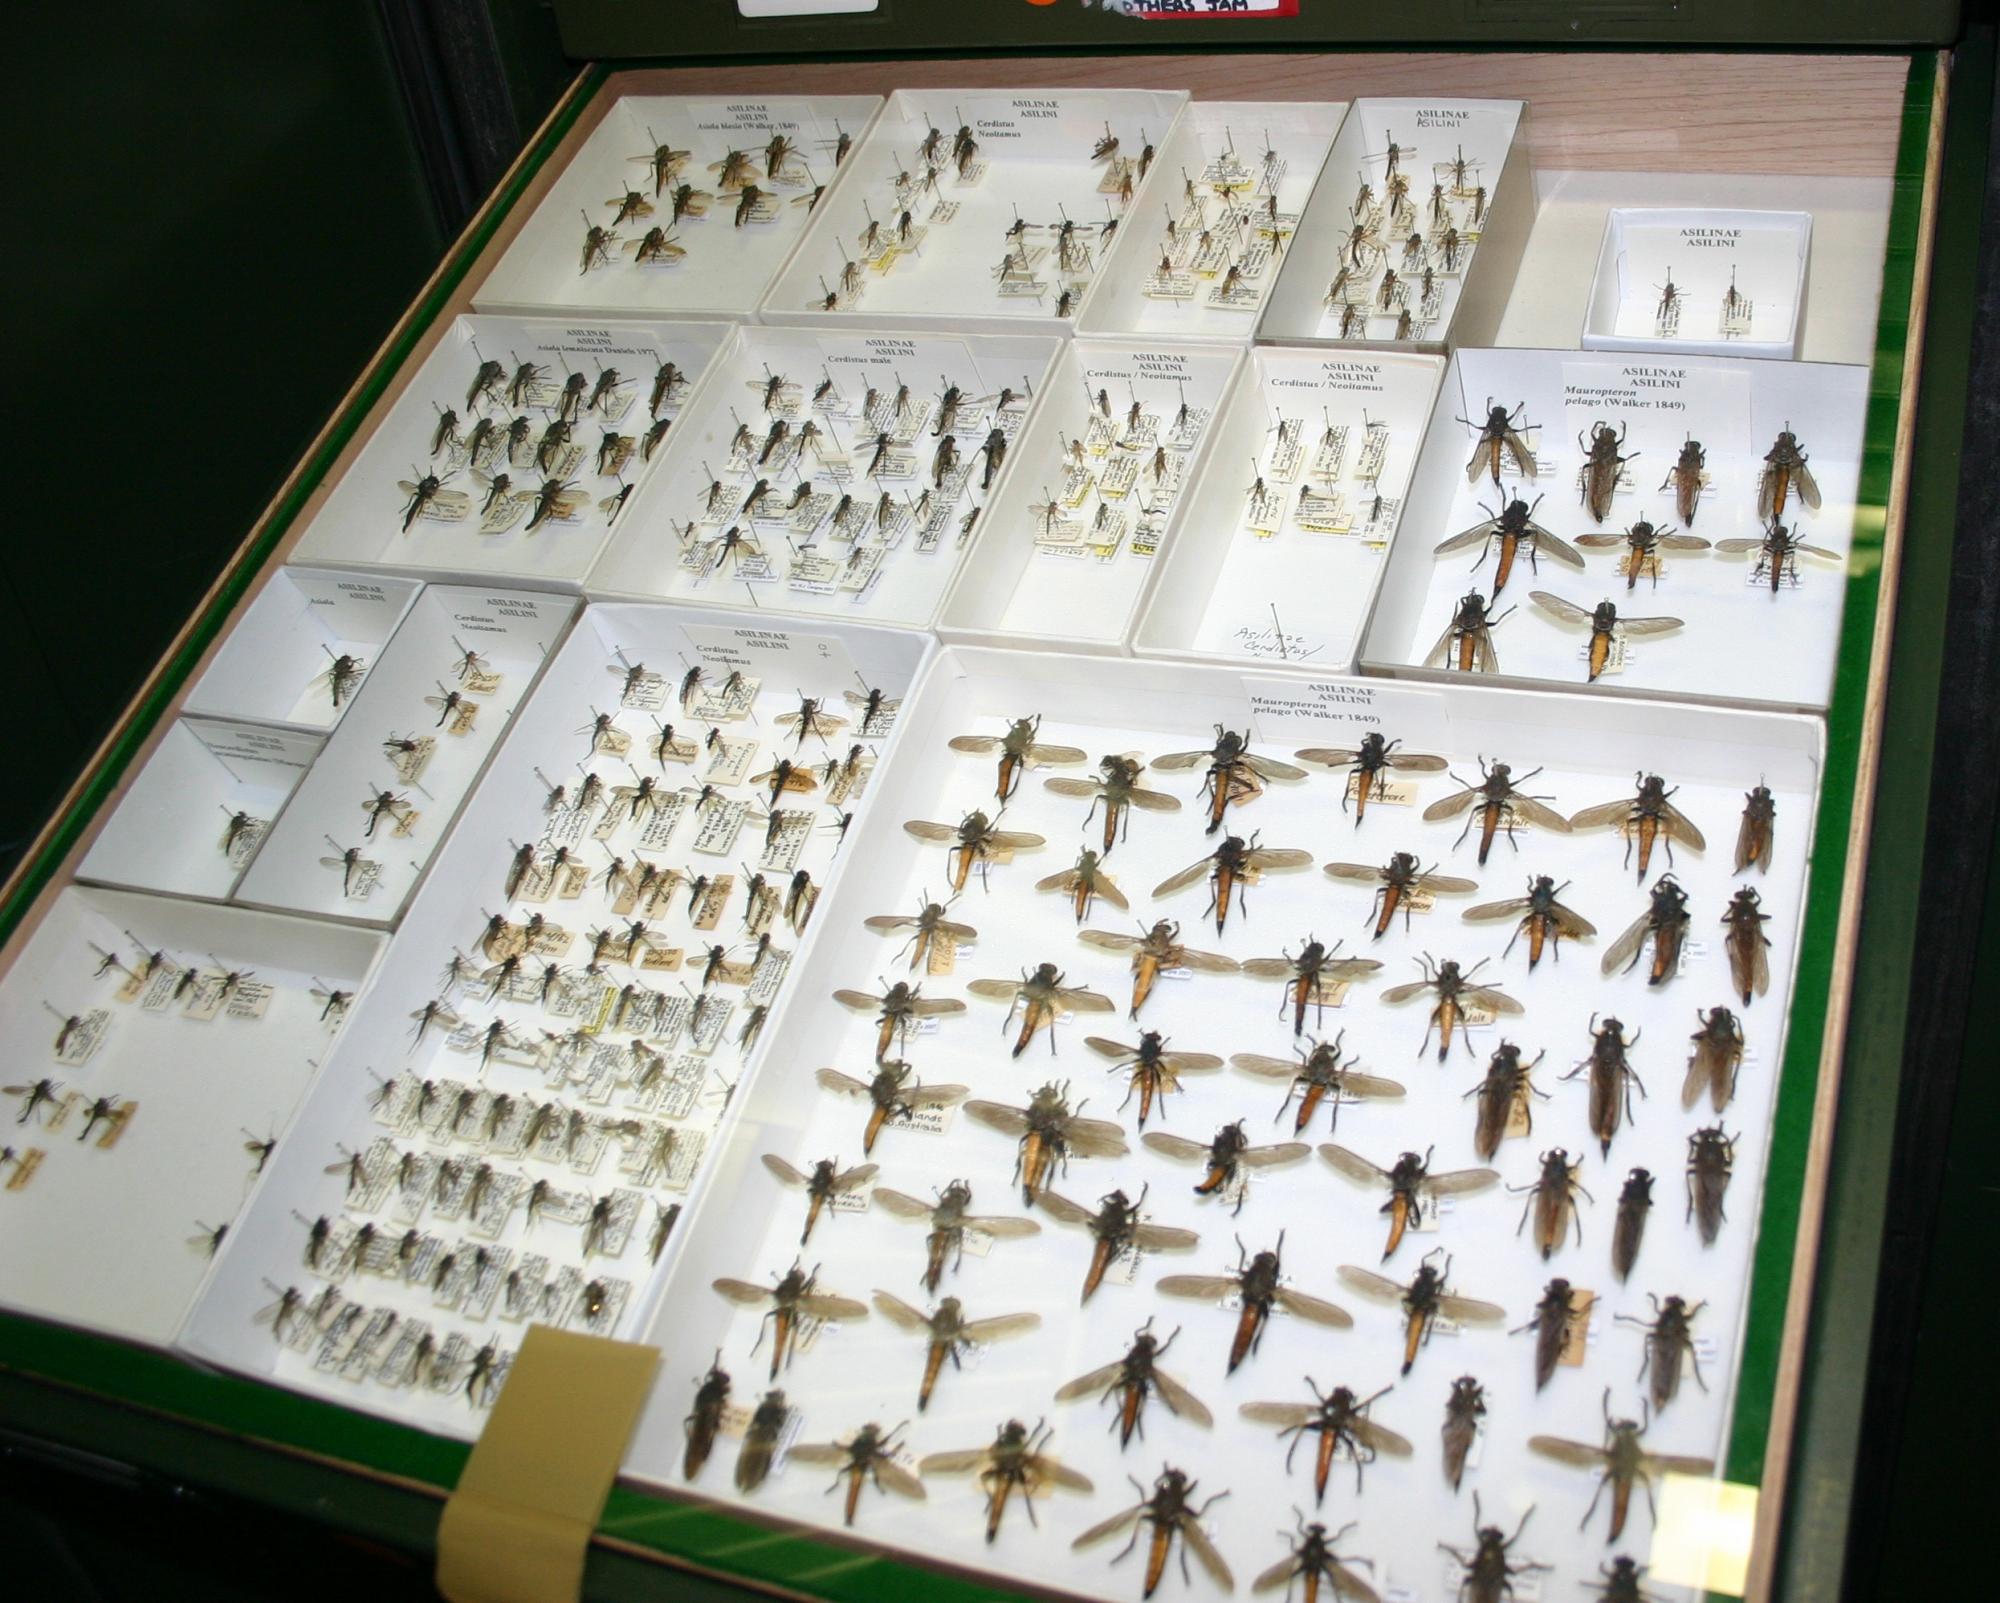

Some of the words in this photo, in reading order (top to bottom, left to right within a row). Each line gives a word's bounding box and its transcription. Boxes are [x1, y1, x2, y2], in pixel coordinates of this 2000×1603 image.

[1205, 0, 1248, 11] JAM
[726, 104, 768, 112] ASILINAE
[1011, 100, 1059, 108] ASILINAE
[1020, 110, 1057, 118] ASILINI
[1416, 110, 1470, 119] ASILINAE
[1417, 118, 1461, 127] ASILINI
[1680, 228, 1741, 237] ASILINAE
[1686, 239, 1736, 247] ASILINI
[566, 329, 612, 337] ASILINAE
[865, 339, 917, 348] ASILINAE
[875, 348, 915, 356] ASILINI
[1132, 353, 1189, 363] ASILINAE
[1138, 363, 1183, 372] ASILINI
[1321, 362, 1382, 373] ASILINAE
[1622, 367, 1687, 378] ASILINAE
[1086, 369, 1131, 378] Cerdistus
[1327, 372, 1375, 382] ASILINI
[1271, 378, 1318, 387] Cerdistus
[1328, 380, 1383, 391] Neoitamus
[1630, 379, 1681, 389] ASILINI
[1564, 385, 1637, 396] Mauropteron
[1604, 397, 1652, 408] (Walker
[1655, 400, 1686, 411] 1849)
[487, 598, 537, 609] ASILINAE
[499, 608, 539, 618] ASILINI
[734, 629, 790, 641] ASILINAE
[696, 644, 739, 655] Cerdistus
[746, 640, 790, 650] ASILINI
[1307, 684, 1376, 697] ASILINAE
[1250, 696, 1328, 709] Mauropteron
[1318, 694, 1372, 705] ASILINI
[1294, 708, 1343, 720] (Walker
[1348, 712, 1381, 724] 1849)
